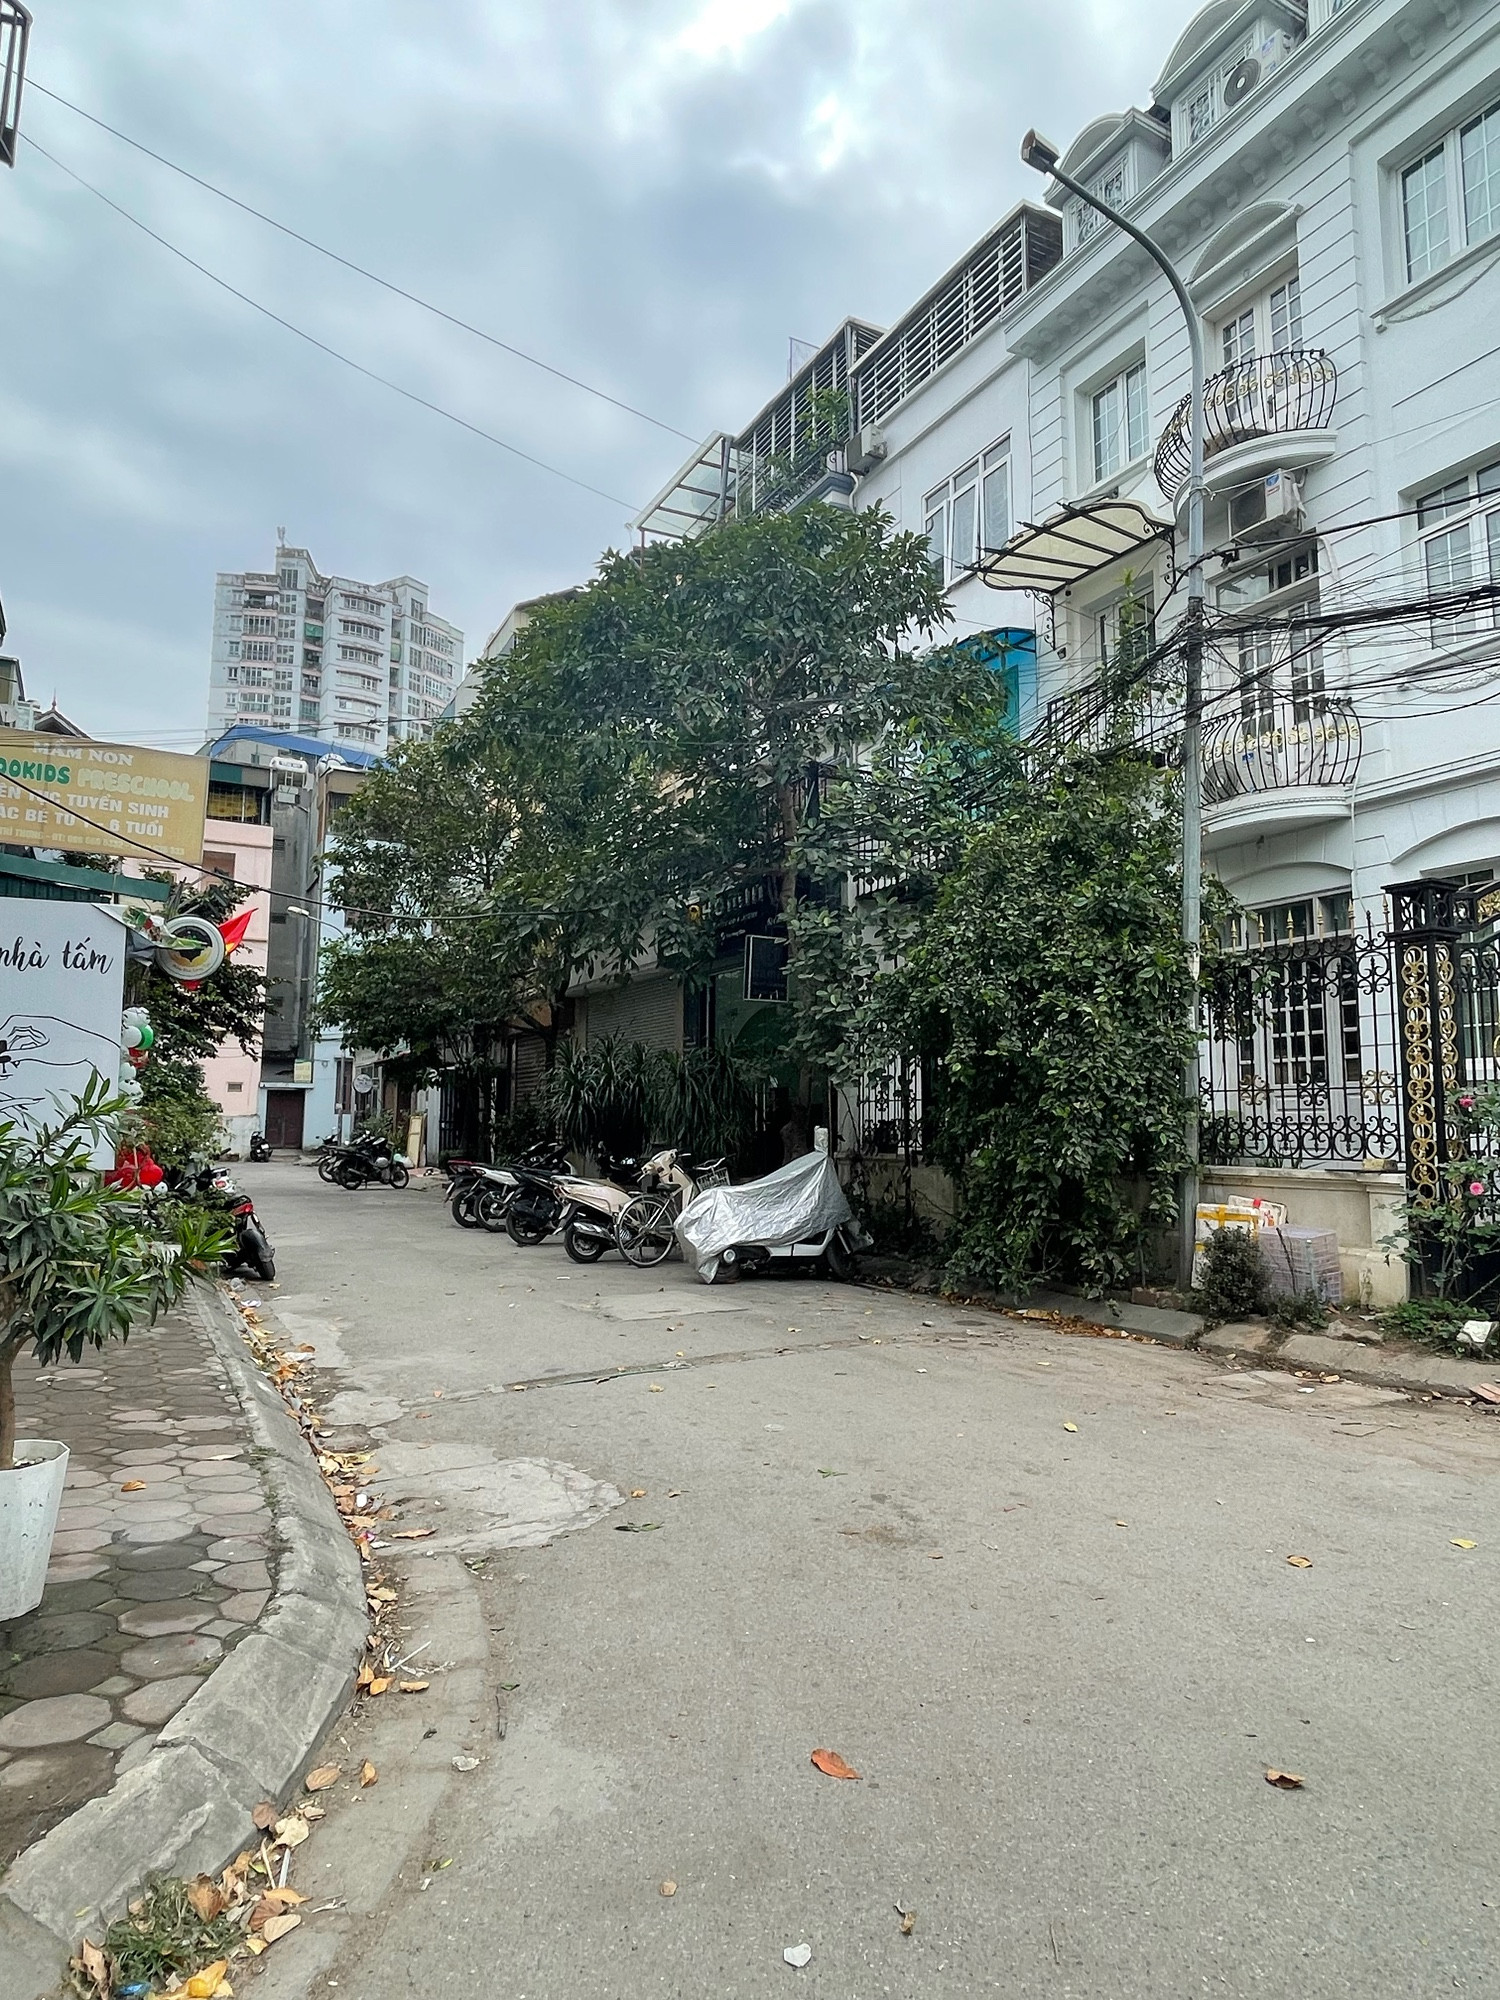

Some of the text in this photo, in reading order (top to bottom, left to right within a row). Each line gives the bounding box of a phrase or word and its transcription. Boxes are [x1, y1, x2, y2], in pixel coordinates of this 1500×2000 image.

[88, 749, 134, 766] NON
[78, 768, 195, 802] PRESCHOOL
[67, 793, 122, 812] TUYỂN
[128, 801, 169, 818] SINH
[109, 818, 120, 832] 6
[126, 819, 164, 837] TUỔI
[0, 936, 49, 972] nhà
